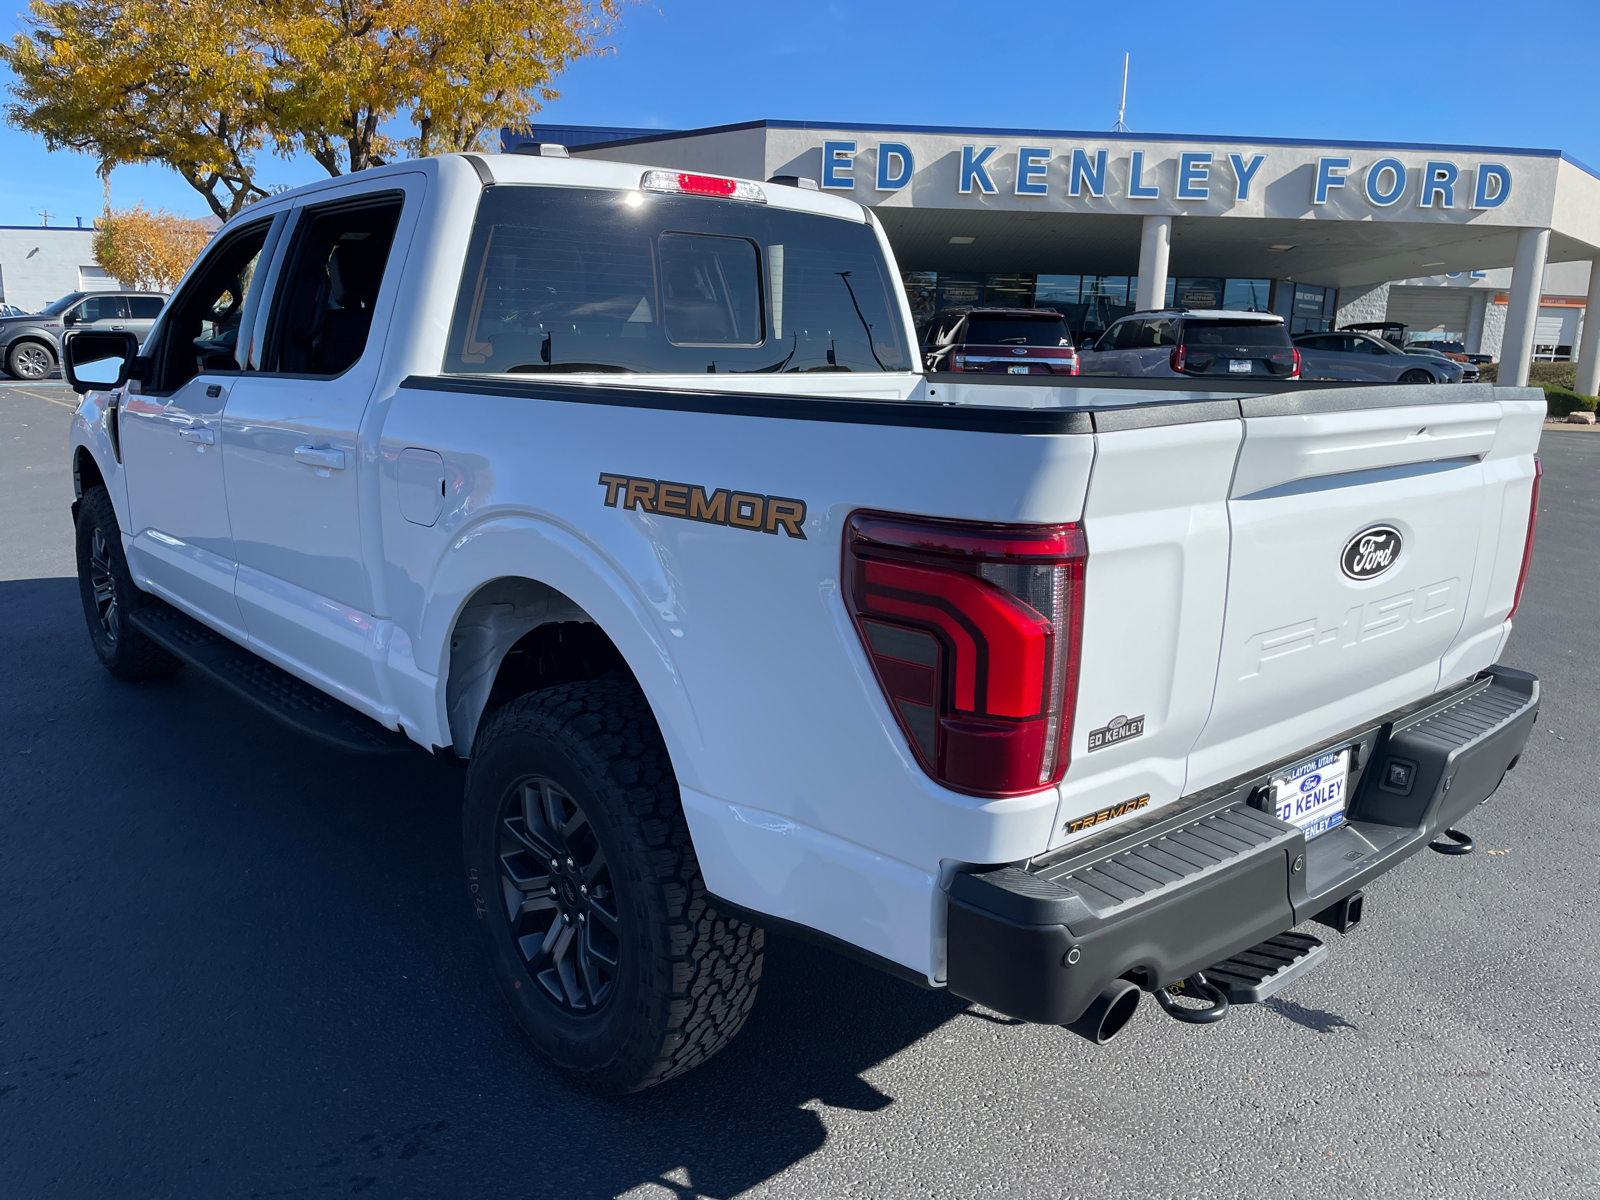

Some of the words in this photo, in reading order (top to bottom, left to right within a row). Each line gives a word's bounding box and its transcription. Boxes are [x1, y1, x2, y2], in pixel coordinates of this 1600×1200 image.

[821, 138, 915, 192] ED
[958, 144, 1268, 201] KENLEY
[1312, 156, 1513, 210] FORD
[598, 472, 807, 540] TREMOR
[1353, 534, 1395, 572] Ford
[1239, 576, 1461, 680] F-150
[1089, 735, 1103, 748] ED
[1105, 720, 1144, 743] KENLEY
[1292, 760, 1316, 779] LAYTON,
[1318, 753, 1334, 768] UTAH
[1303, 775, 1319, 791] Ford
[1066, 794, 1150, 834] TREMOR
[1295, 779, 1343, 816] KENLEY
[1302, 817, 1331, 840] ENLEY
